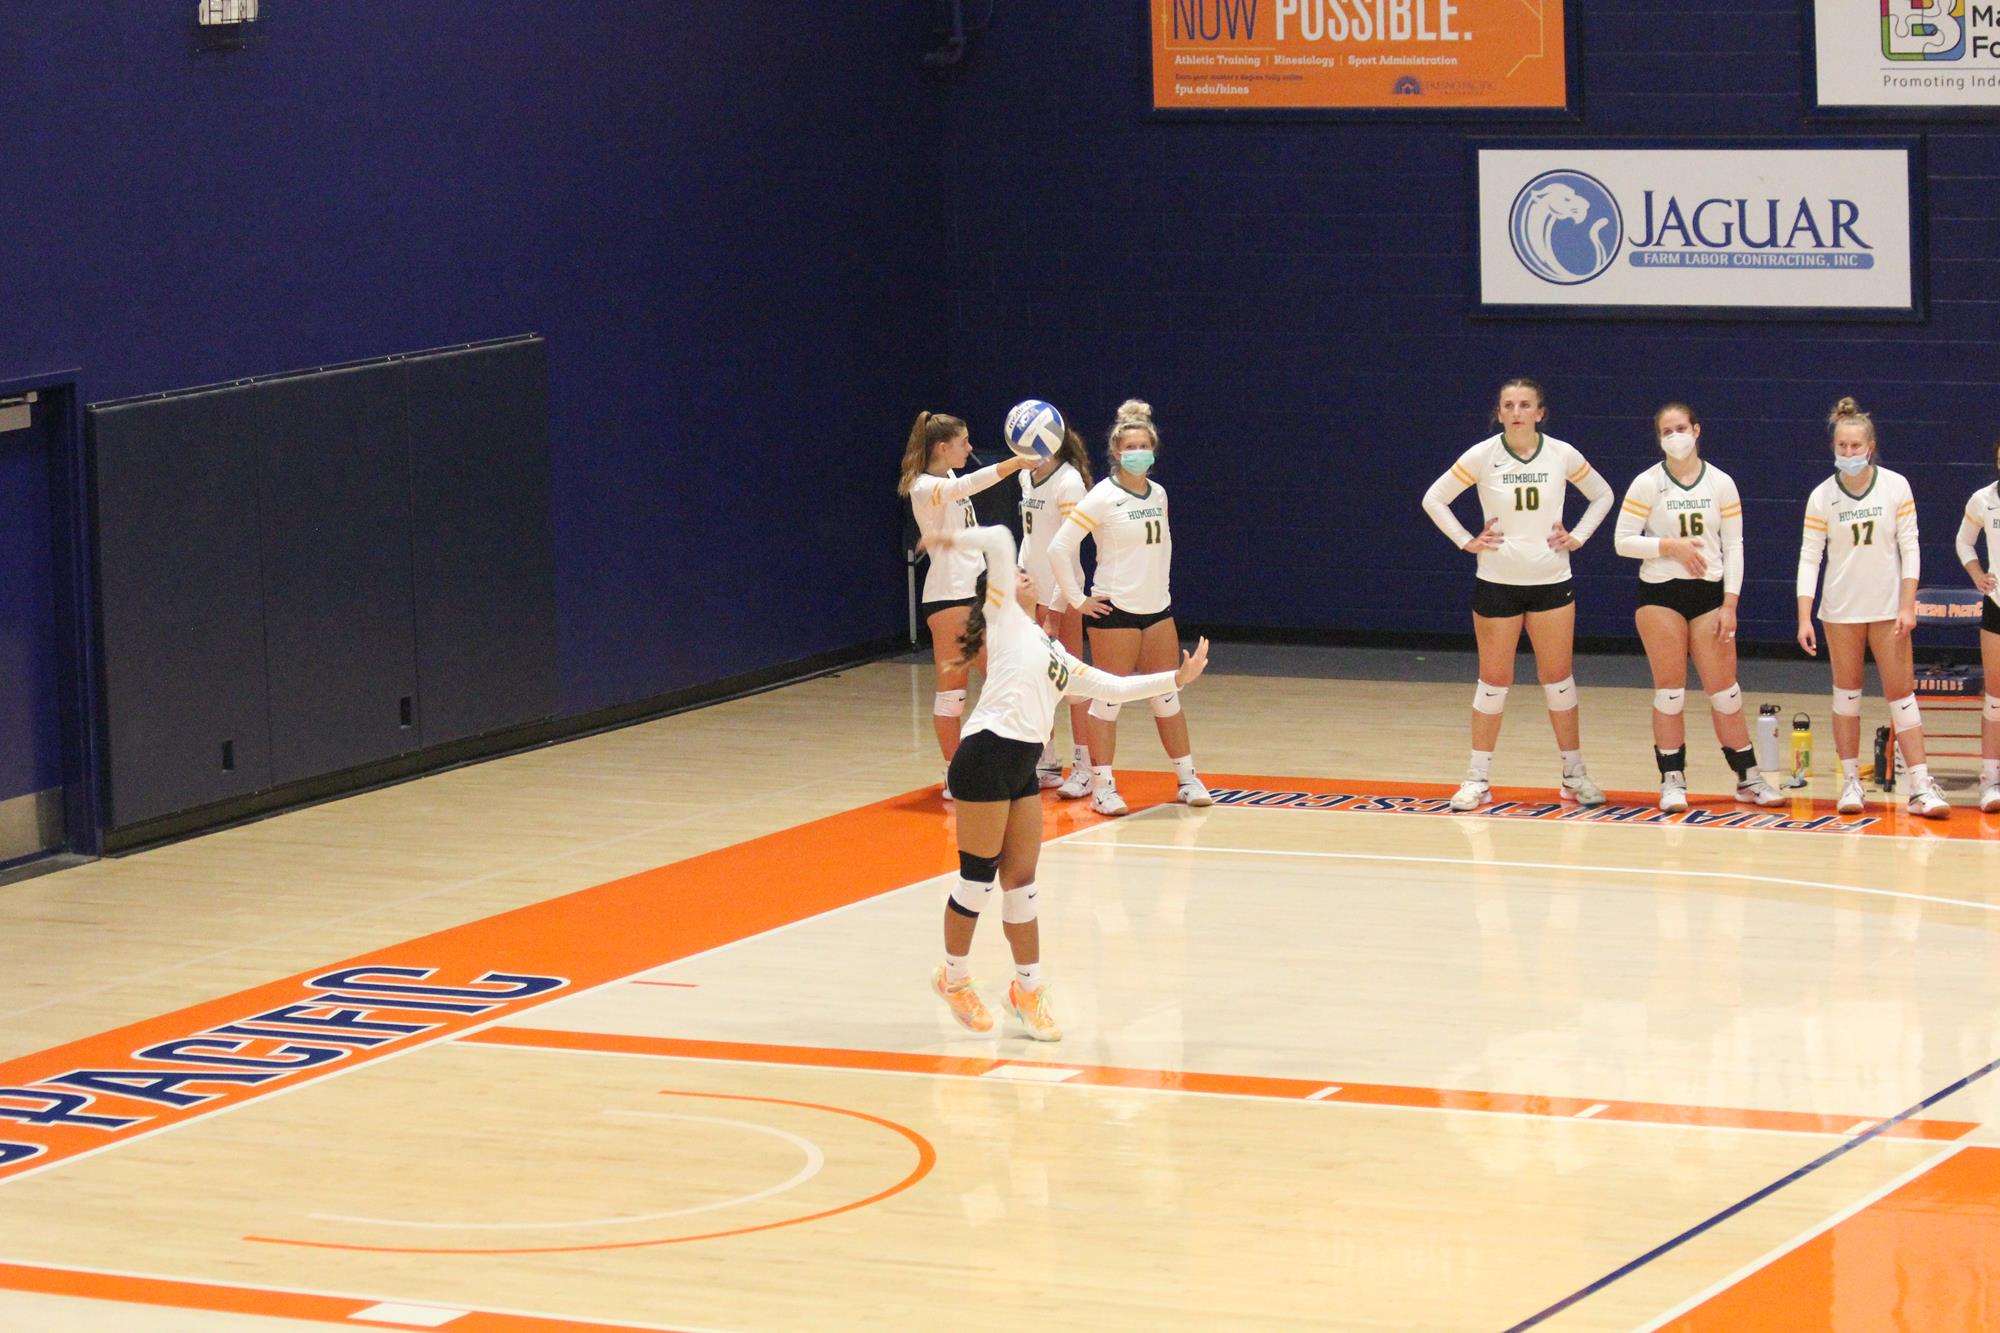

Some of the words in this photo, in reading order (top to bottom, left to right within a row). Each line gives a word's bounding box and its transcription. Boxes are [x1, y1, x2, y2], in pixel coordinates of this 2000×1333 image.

[1174, 0, 1258, 40] NOW
[1276, 0, 1473, 41] POSSIBLE.
[1175, 55, 1215, 65] Athletic
[1217, 55, 1261, 67] Training
[1274, 55, 1335, 67] Kinesiology
[1348, 55, 1377, 67] Sport
[1379, 55, 1457, 65] Administration
[1175, 84, 1249, 96] fpu.edu/kines
[1883, 75, 1964, 90] Promoting
[1972, 75, 2000, 87] Ind
[1628, 190, 1874, 249] JAGUAR
[1644, 253, 1681, 264] FARM
[1686, 254, 1728, 265] LABOR
[1733, 254, 1830, 267] CONTRACTING,
[1834, 255, 1858, 266] INC
[1502, 472, 1549, 484] HUMBOLDT
[1514, 486, 1540, 511] 10
[1666, 498, 1711, 510] HUMBOLDT
[1128, 507, 1162, 520] HUMBOLDT
[1838, 506, 1883, 522] HUMBOLDT
[1025, 511, 1033, 535] 9
[1678, 512, 1704, 538] 16
[1145, 520, 1161, 545] 11
[1851, 520, 1874, 546] 17
